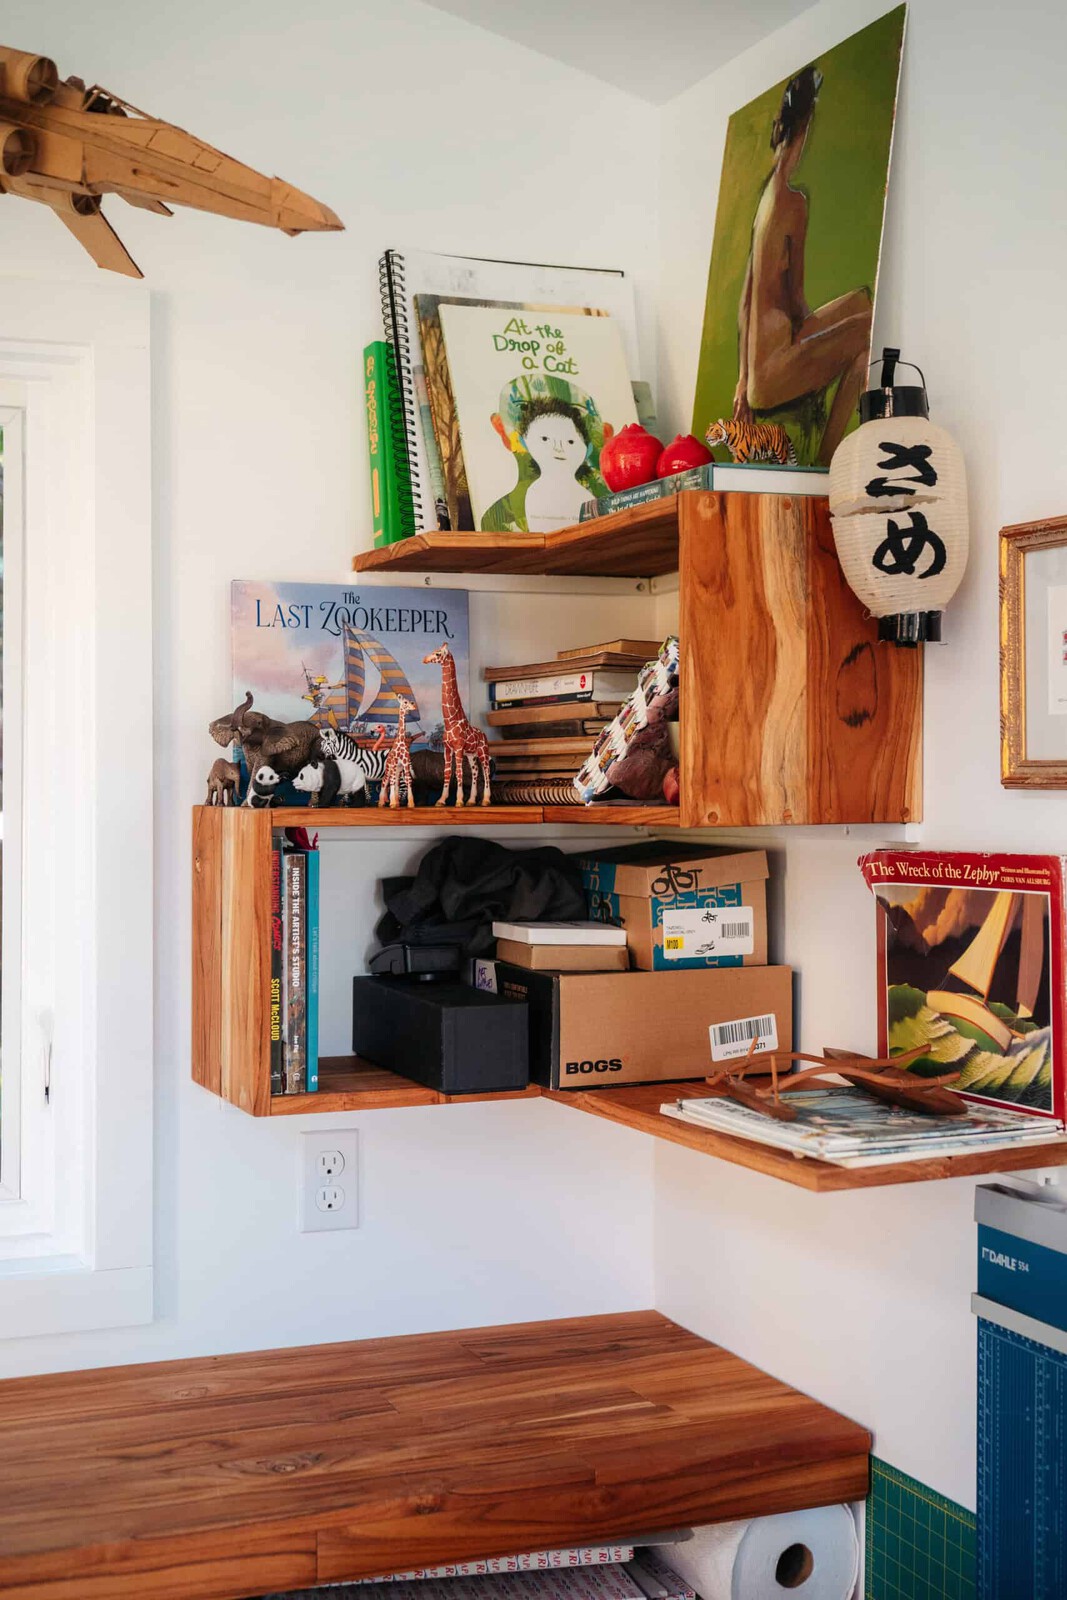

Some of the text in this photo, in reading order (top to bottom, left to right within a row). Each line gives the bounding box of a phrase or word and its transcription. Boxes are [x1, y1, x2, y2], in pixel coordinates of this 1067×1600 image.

[503, 317, 564, 339] At the
[492, 334, 567, 357] Drop of
[521, 355, 579, 375] a Cat
[341, 591, 361, 605] The
[255, 598, 455, 638] LAST ZOOKEEPER
[866, 862, 1000, 885] The Wreck of the Zephyr
[292, 867, 300, 988] INSIDE THE ARTIST'S STUDIO
[271, 978, 280, 1041] SCOTT McCLOUD
[566, 1059, 622, 1075] BOGS
[989, 1250, 1016, 1271] DAHLE
